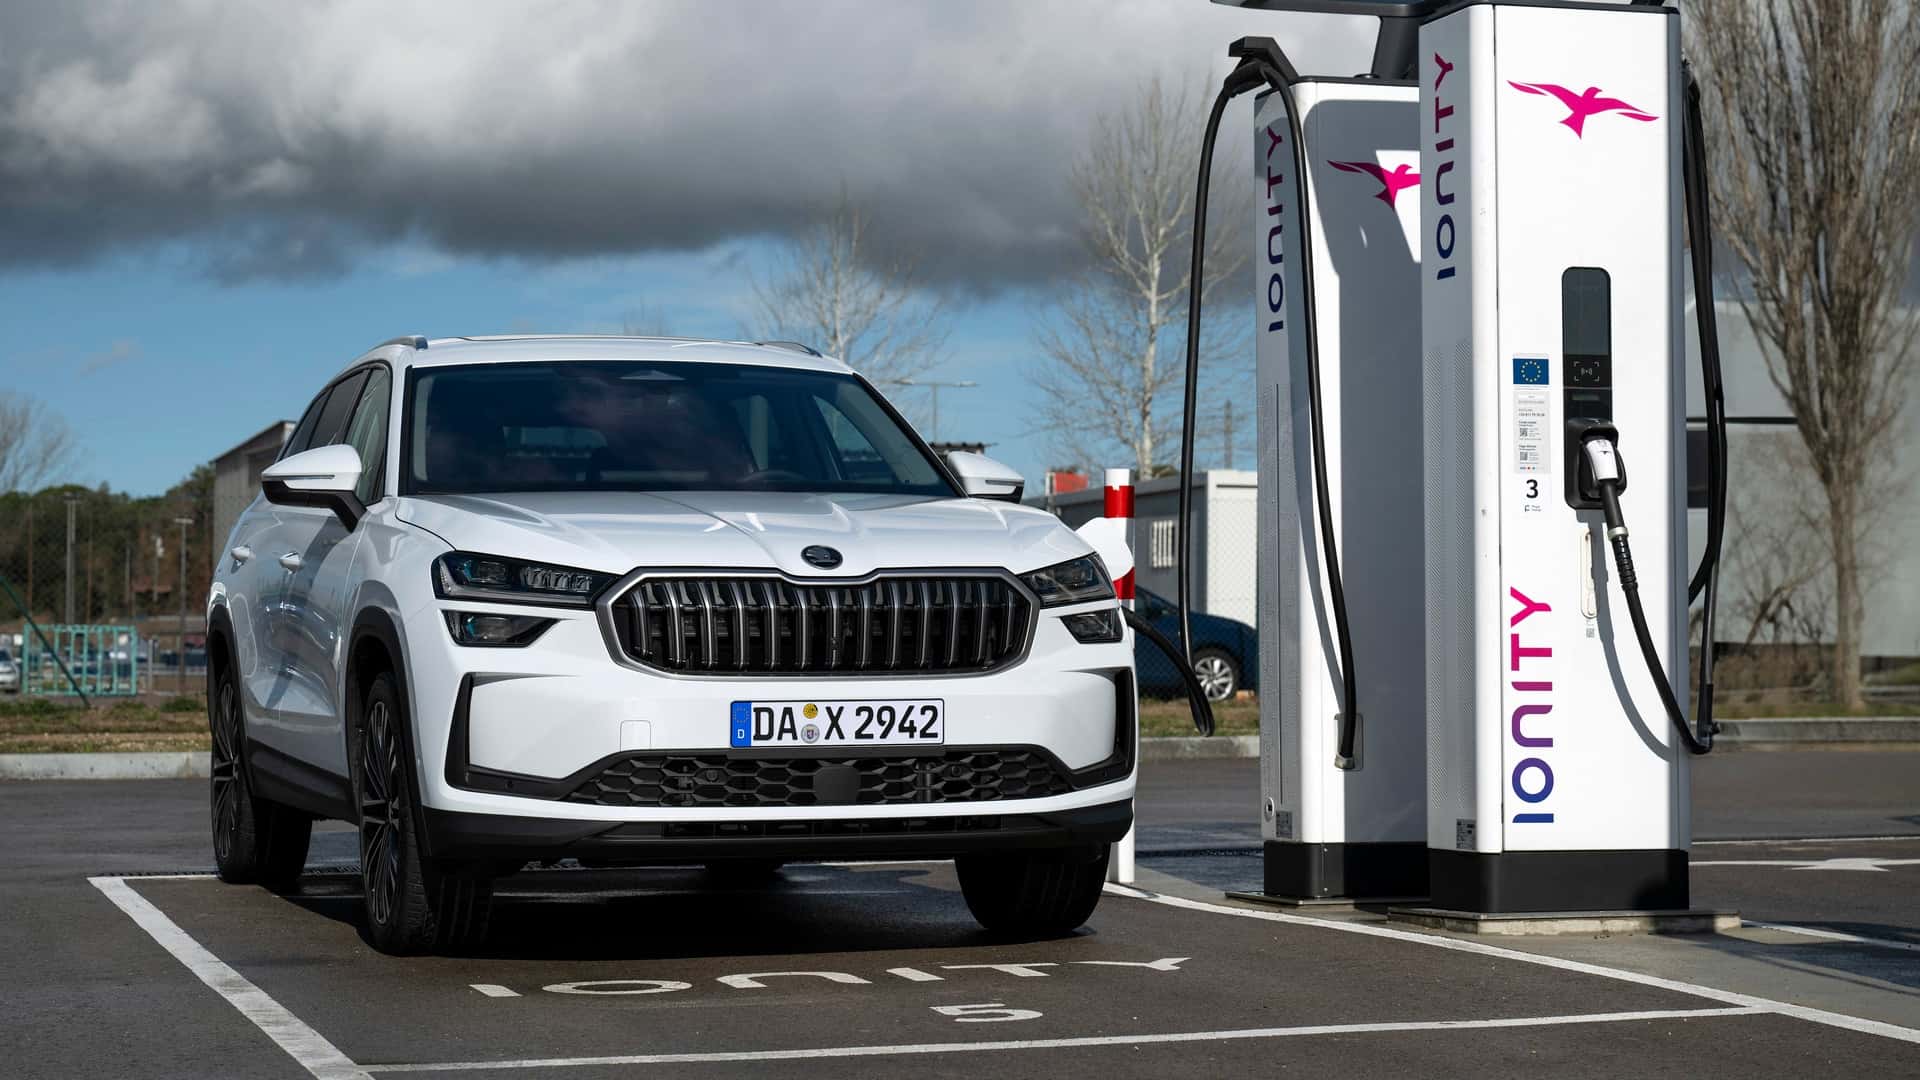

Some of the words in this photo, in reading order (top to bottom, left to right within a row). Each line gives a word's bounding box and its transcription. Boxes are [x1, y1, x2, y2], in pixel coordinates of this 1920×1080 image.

[1434, 52, 1456, 280] IONITY
[1266, 126, 1284, 332] IONITY
[1526, 478, 1539, 499] 3
[753, 706, 798, 741] DA
[824, 705, 845, 740] X
[854, 705, 938, 740] 2942
[1510, 586, 1554, 823] IONITY
[737, 729, 745, 739] D
[469, 957, 1191, 998] IONITY
[929, 1002, 1044, 1023] 5
